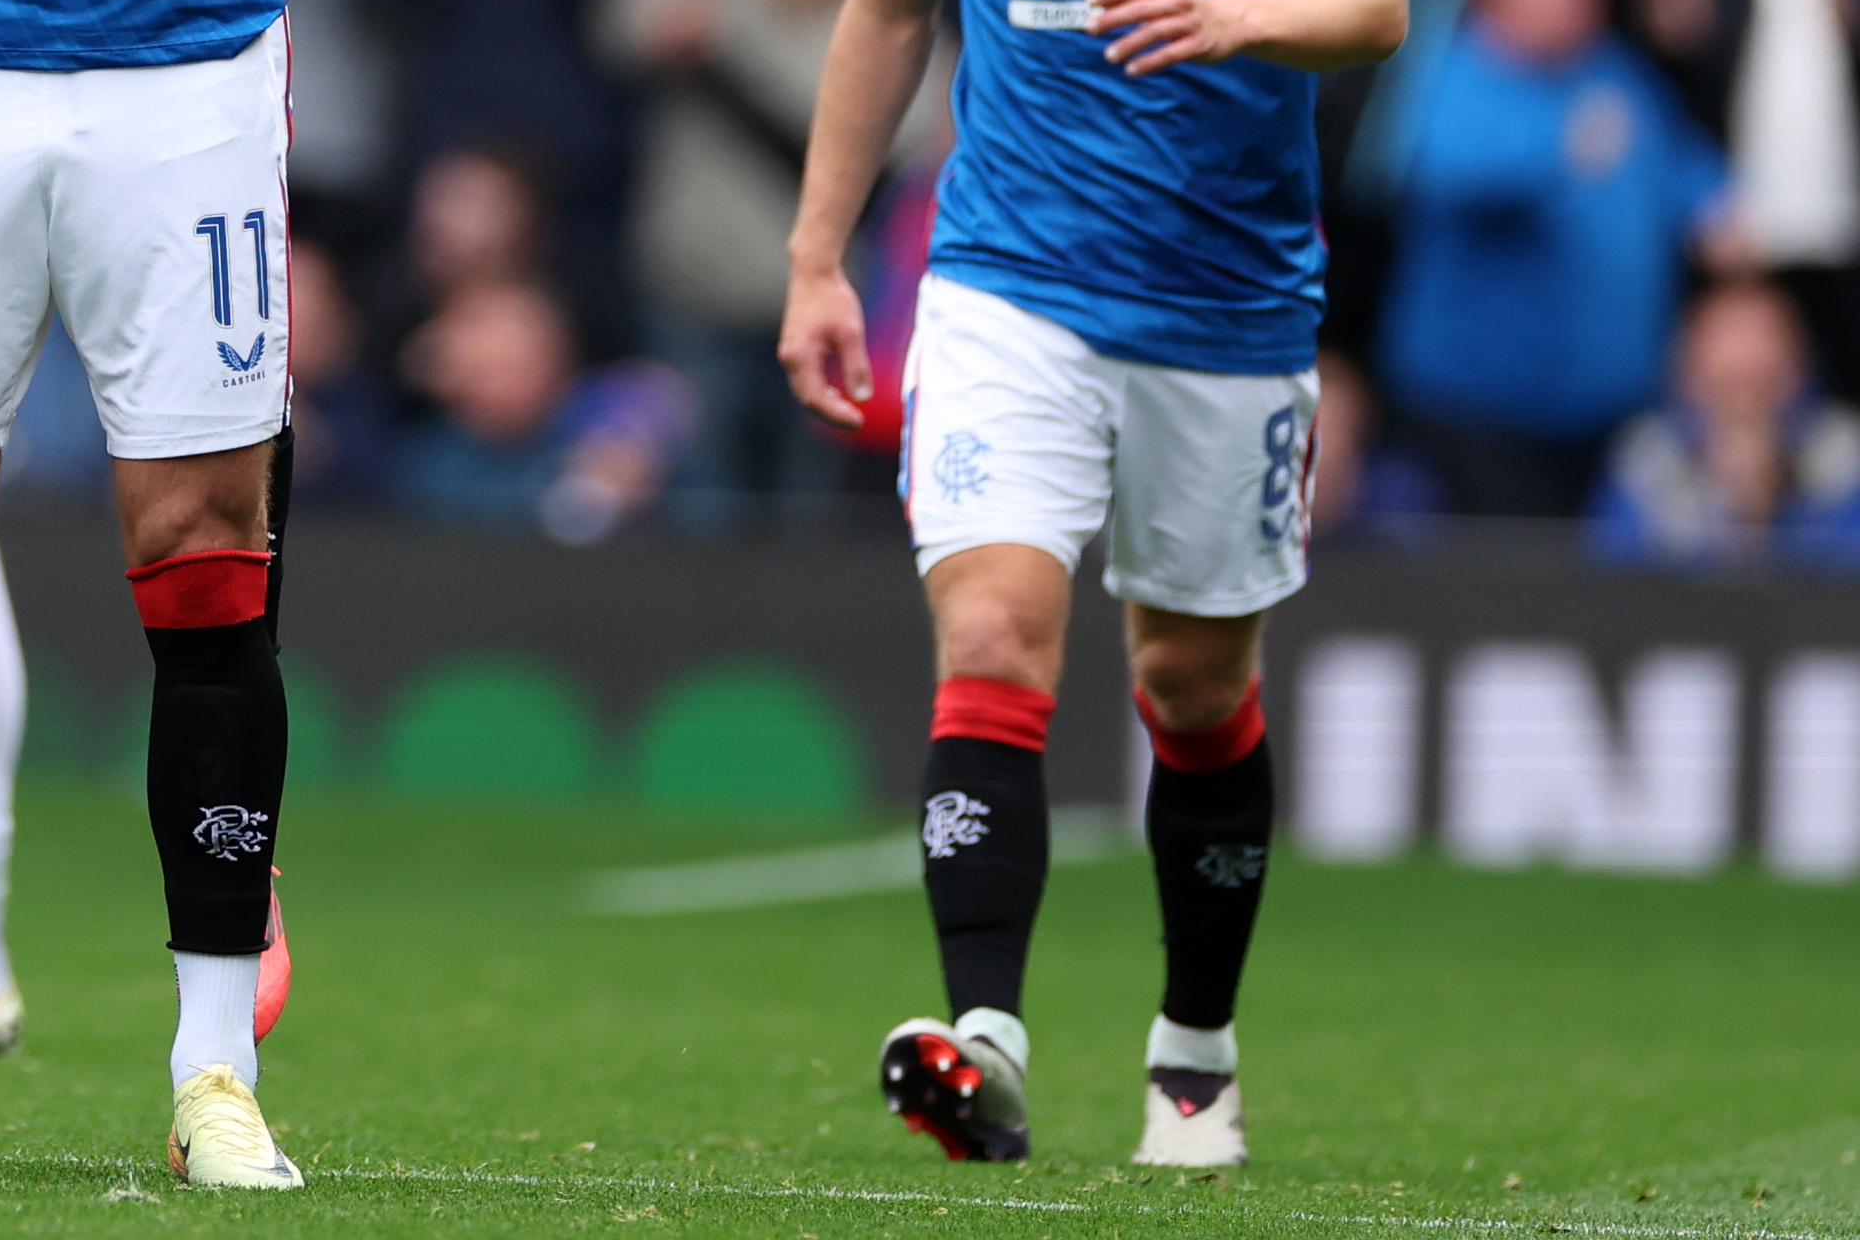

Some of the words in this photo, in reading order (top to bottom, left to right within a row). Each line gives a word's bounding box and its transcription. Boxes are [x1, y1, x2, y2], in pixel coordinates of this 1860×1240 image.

[194, 208, 271, 328] 11
[222, 369, 267, 388] CASTORE
[1263, 404, 1295, 508] 8
